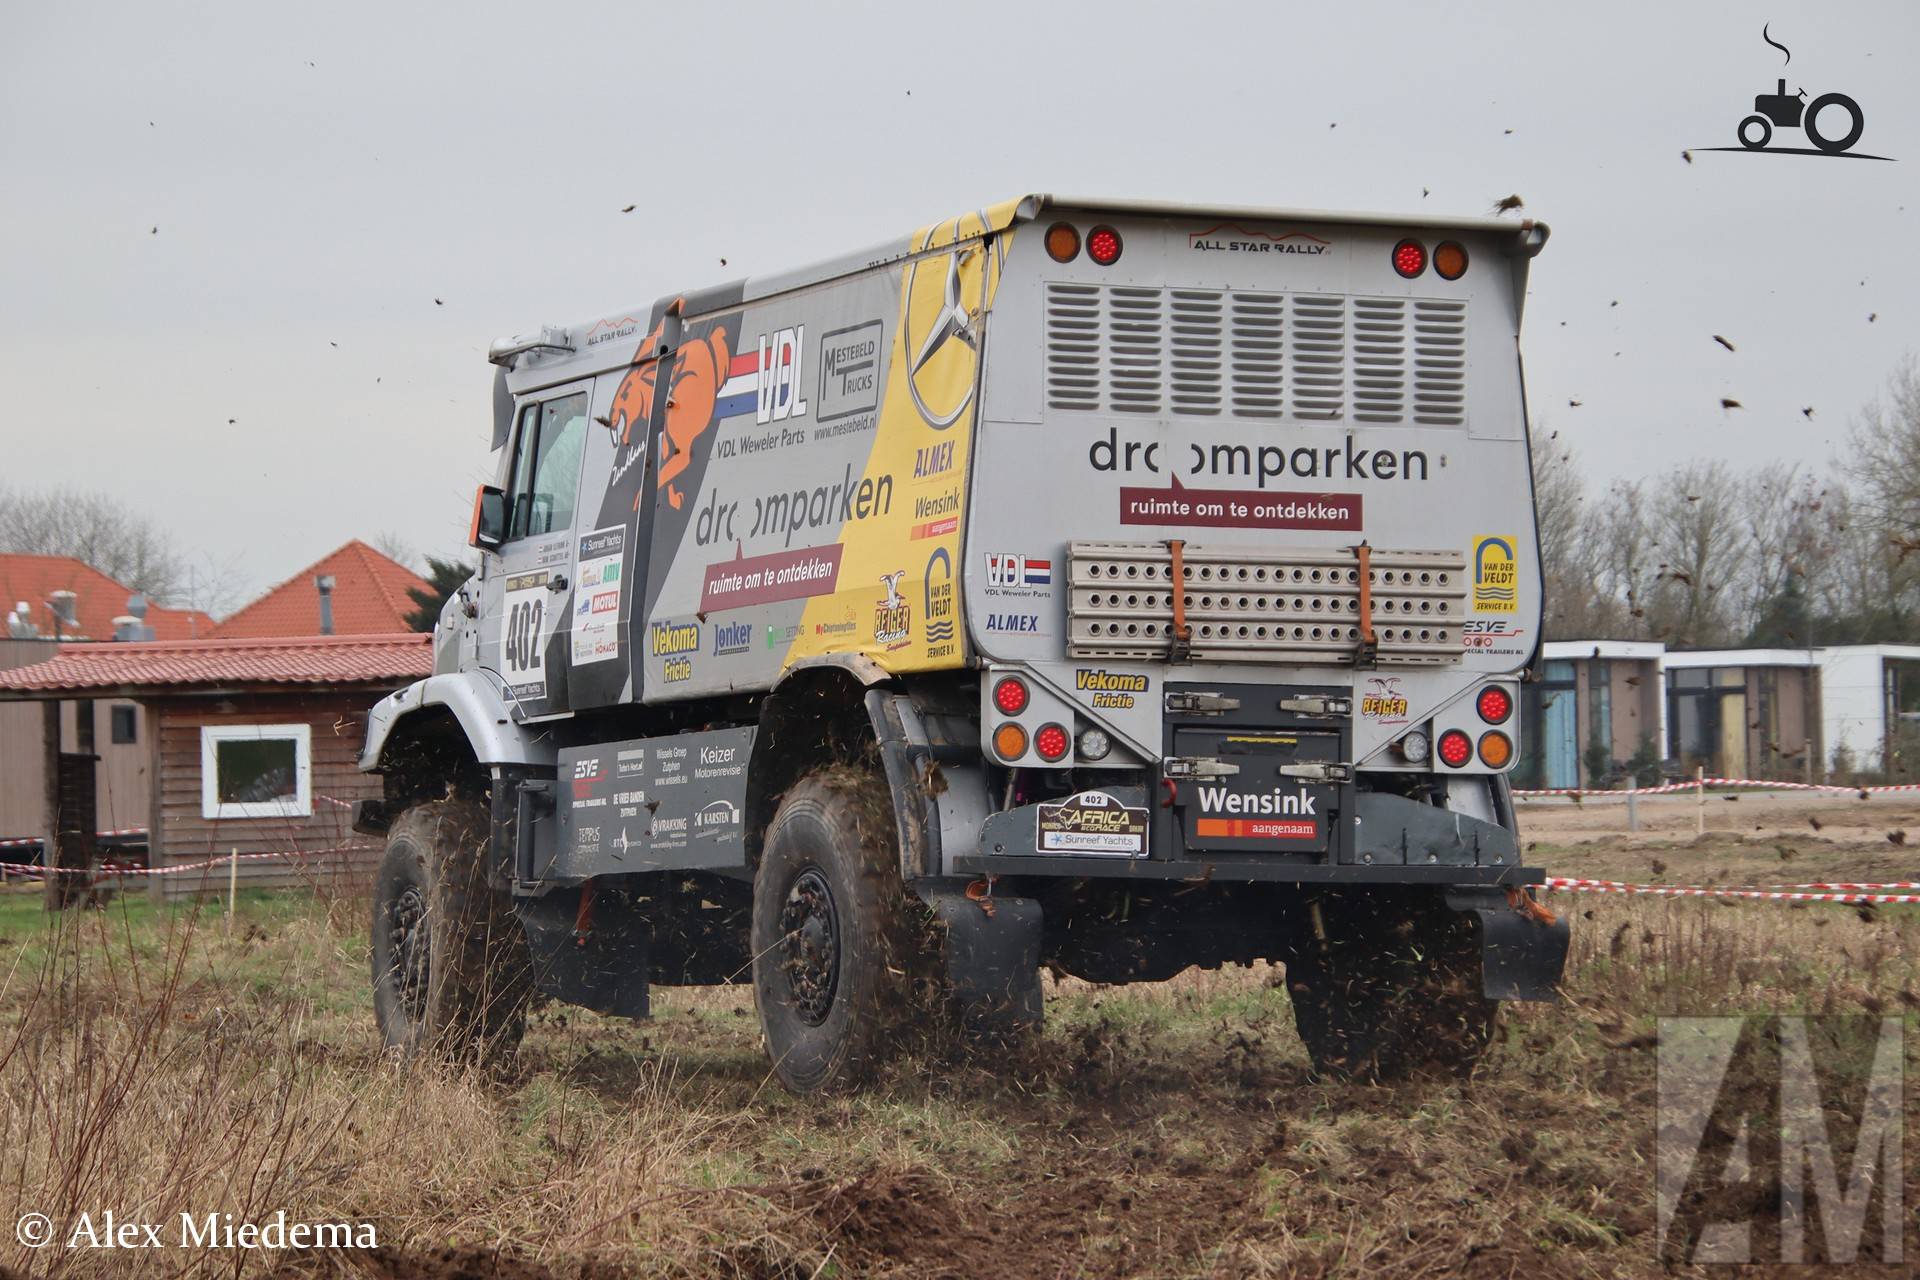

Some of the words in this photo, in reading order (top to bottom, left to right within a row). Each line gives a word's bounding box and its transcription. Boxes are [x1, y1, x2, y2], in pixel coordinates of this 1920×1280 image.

[1193, 239, 1226, 251] ALL
[1229, 241, 1271, 253] STAR
[1273, 243, 1326, 255] RALLY
[586, 335, 600, 346] ALL
[600, 330, 616, 343] STAR
[616, 327, 636, 338] RALLY
[823, 340, 875, 377] MESTEBELD
[756, 324, 807, 425] VDL
[835, 360, 874, 396] TRUCKS
[814, 415, 877, 441] www.mestebeld.nl
[717, 439, 738, 459] VDL
[740, 432, 779, 455] Weweler
[781, 428, 805, 446] Parts
[913, 439, 955, 479] ALMEX
[914, 486, 960, 519] Wensink
[1131, 498, 1190, 516] ruimte
[1196, 503, 1224, 517] om
[1230, 501, 1248, 518] te
[1254, 502, 1349, 520] ontdekken
[708, 573, 742, 595] ruimte
[744, 572, 761, 589] om
[764, 567, 775, 586] te
[776, 557, 833, 583] ontdekken
[984, 552, 1033, 588] VDL
[1484, 562, 1498, 570] VAN
[1500, 562, 1514, 571] DER
[1484, 572, 1514, 584] VELDT
[930, 585, 940, 599] VAN
[941, 583, 951, 597] DER
[984, 588, 999, 596] VDL
[1002, 589, 1031, 597] Weweler
[1033, 590, 1051, 598] Parts
[593, 592, 617, 611] MOTUL
[931, 598, 951, 618] VELDT
[1476, 602, 1501, 610] SERVICE
[874, 605, 911, 637] REIGER
[985, 614, 1039, 632] ALMEX
[1463, 621, 1508, 633] ESVE
[506, 599, 542, 672] 402
[652, 620, 700, 657] Vekoma
[713, 621, 752, 656] Jonker
[875, 628, 907, 644] Racing
[927, 645, 946, 658] SERVICE
[663, 656, 692, 684] Frictie
[1076, 668, 1150, 693] Vekoma
[1092, 692, 1135, 709] Frictie
[1361, 697, 1408, 716] REIGER
[700, 745, 736, 765] Keizer
[574, 758, 600, 779] ESVE
[694, 764, 741, 779] Motorenrevisie
[1084, 795, 1102, 804] 402
[1198, 786, 1316, 815] Wensink
[658, 817, 687, 832] VRAKKING
[704, 810, 730, 825] KARSTEN
[1067, 809, 1130, 825] AFRICA
[1252, 824, 1313, 836] aangenaam
[1065, 834, 1101, 844] Sunreef
[1102, 836, 1134, 846] Yachts
